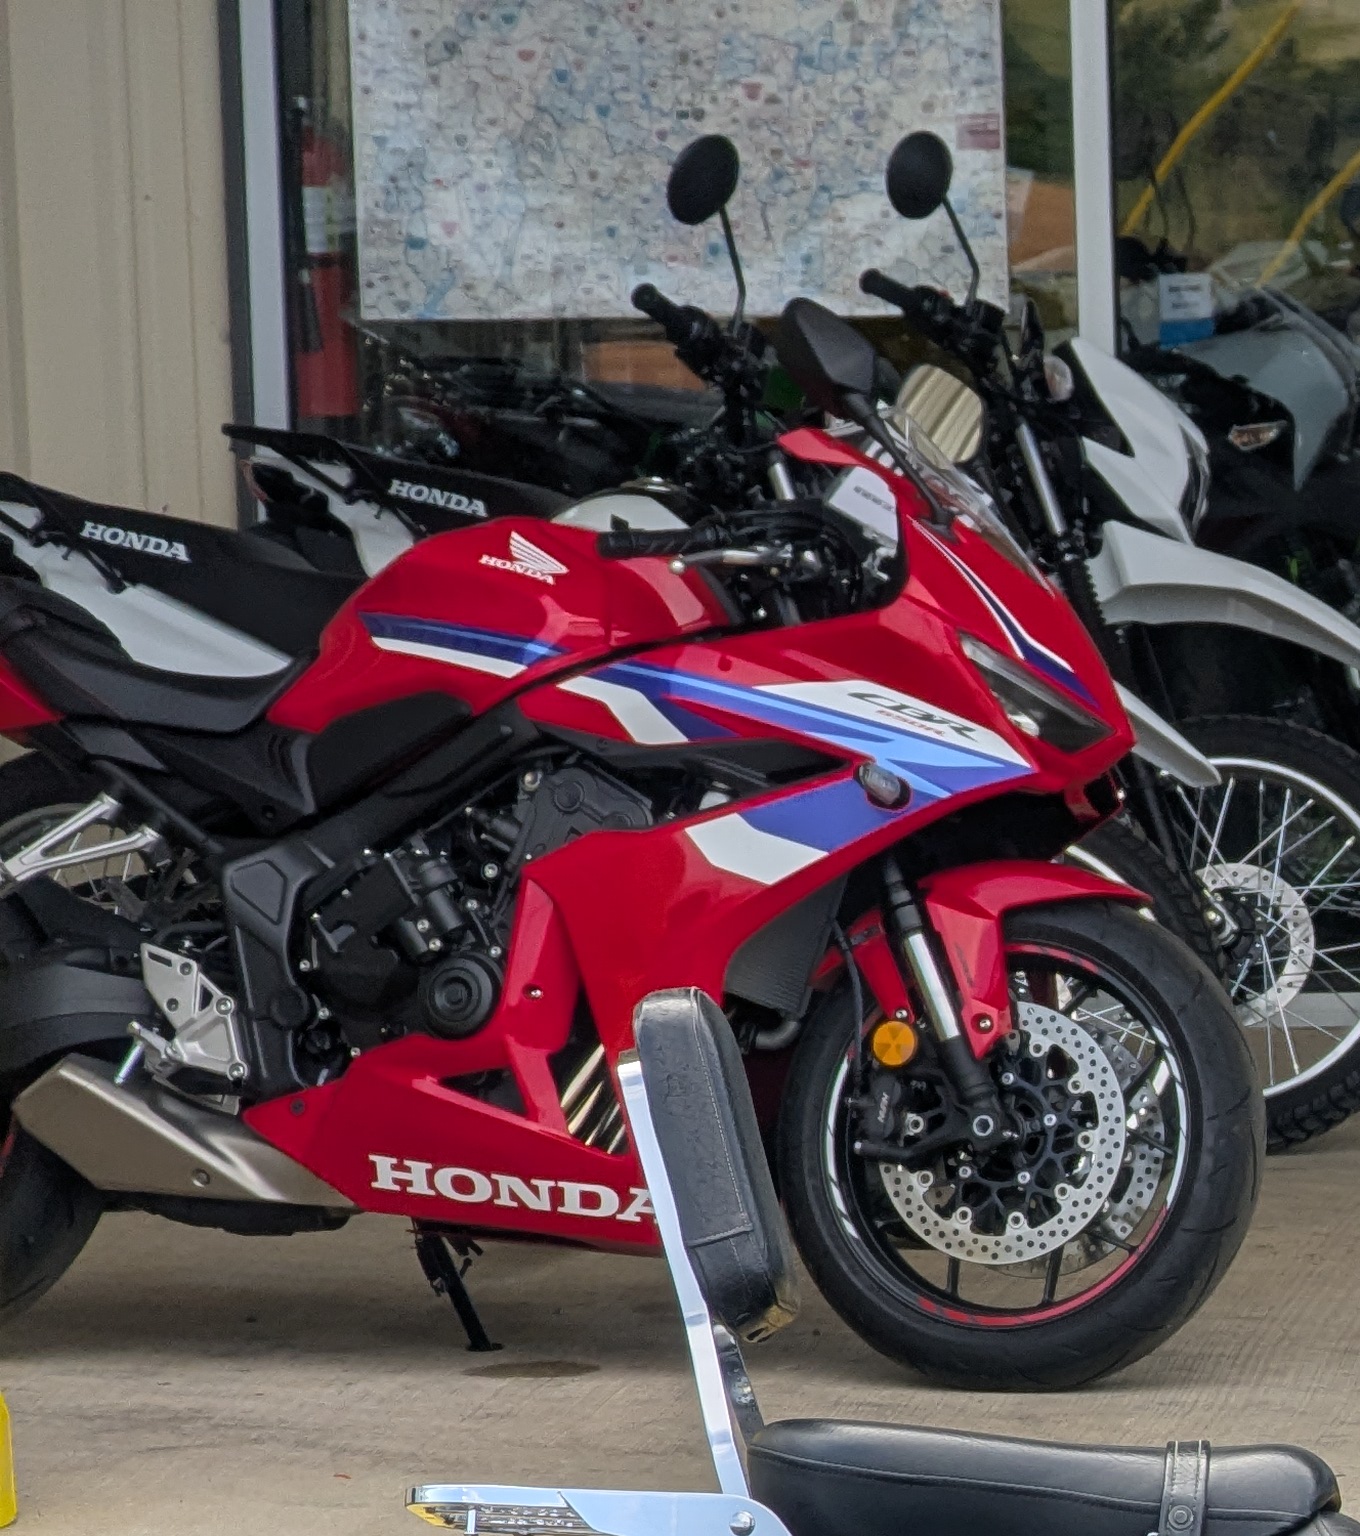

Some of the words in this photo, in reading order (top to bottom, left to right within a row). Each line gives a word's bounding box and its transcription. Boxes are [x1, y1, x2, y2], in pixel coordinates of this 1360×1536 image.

[387, 479, 488, 517] HONDA
[80, 520, 192, 563] HONDA
[478, 553, 555, 585] HONDA
[847, 692, 978, 743] CBR
